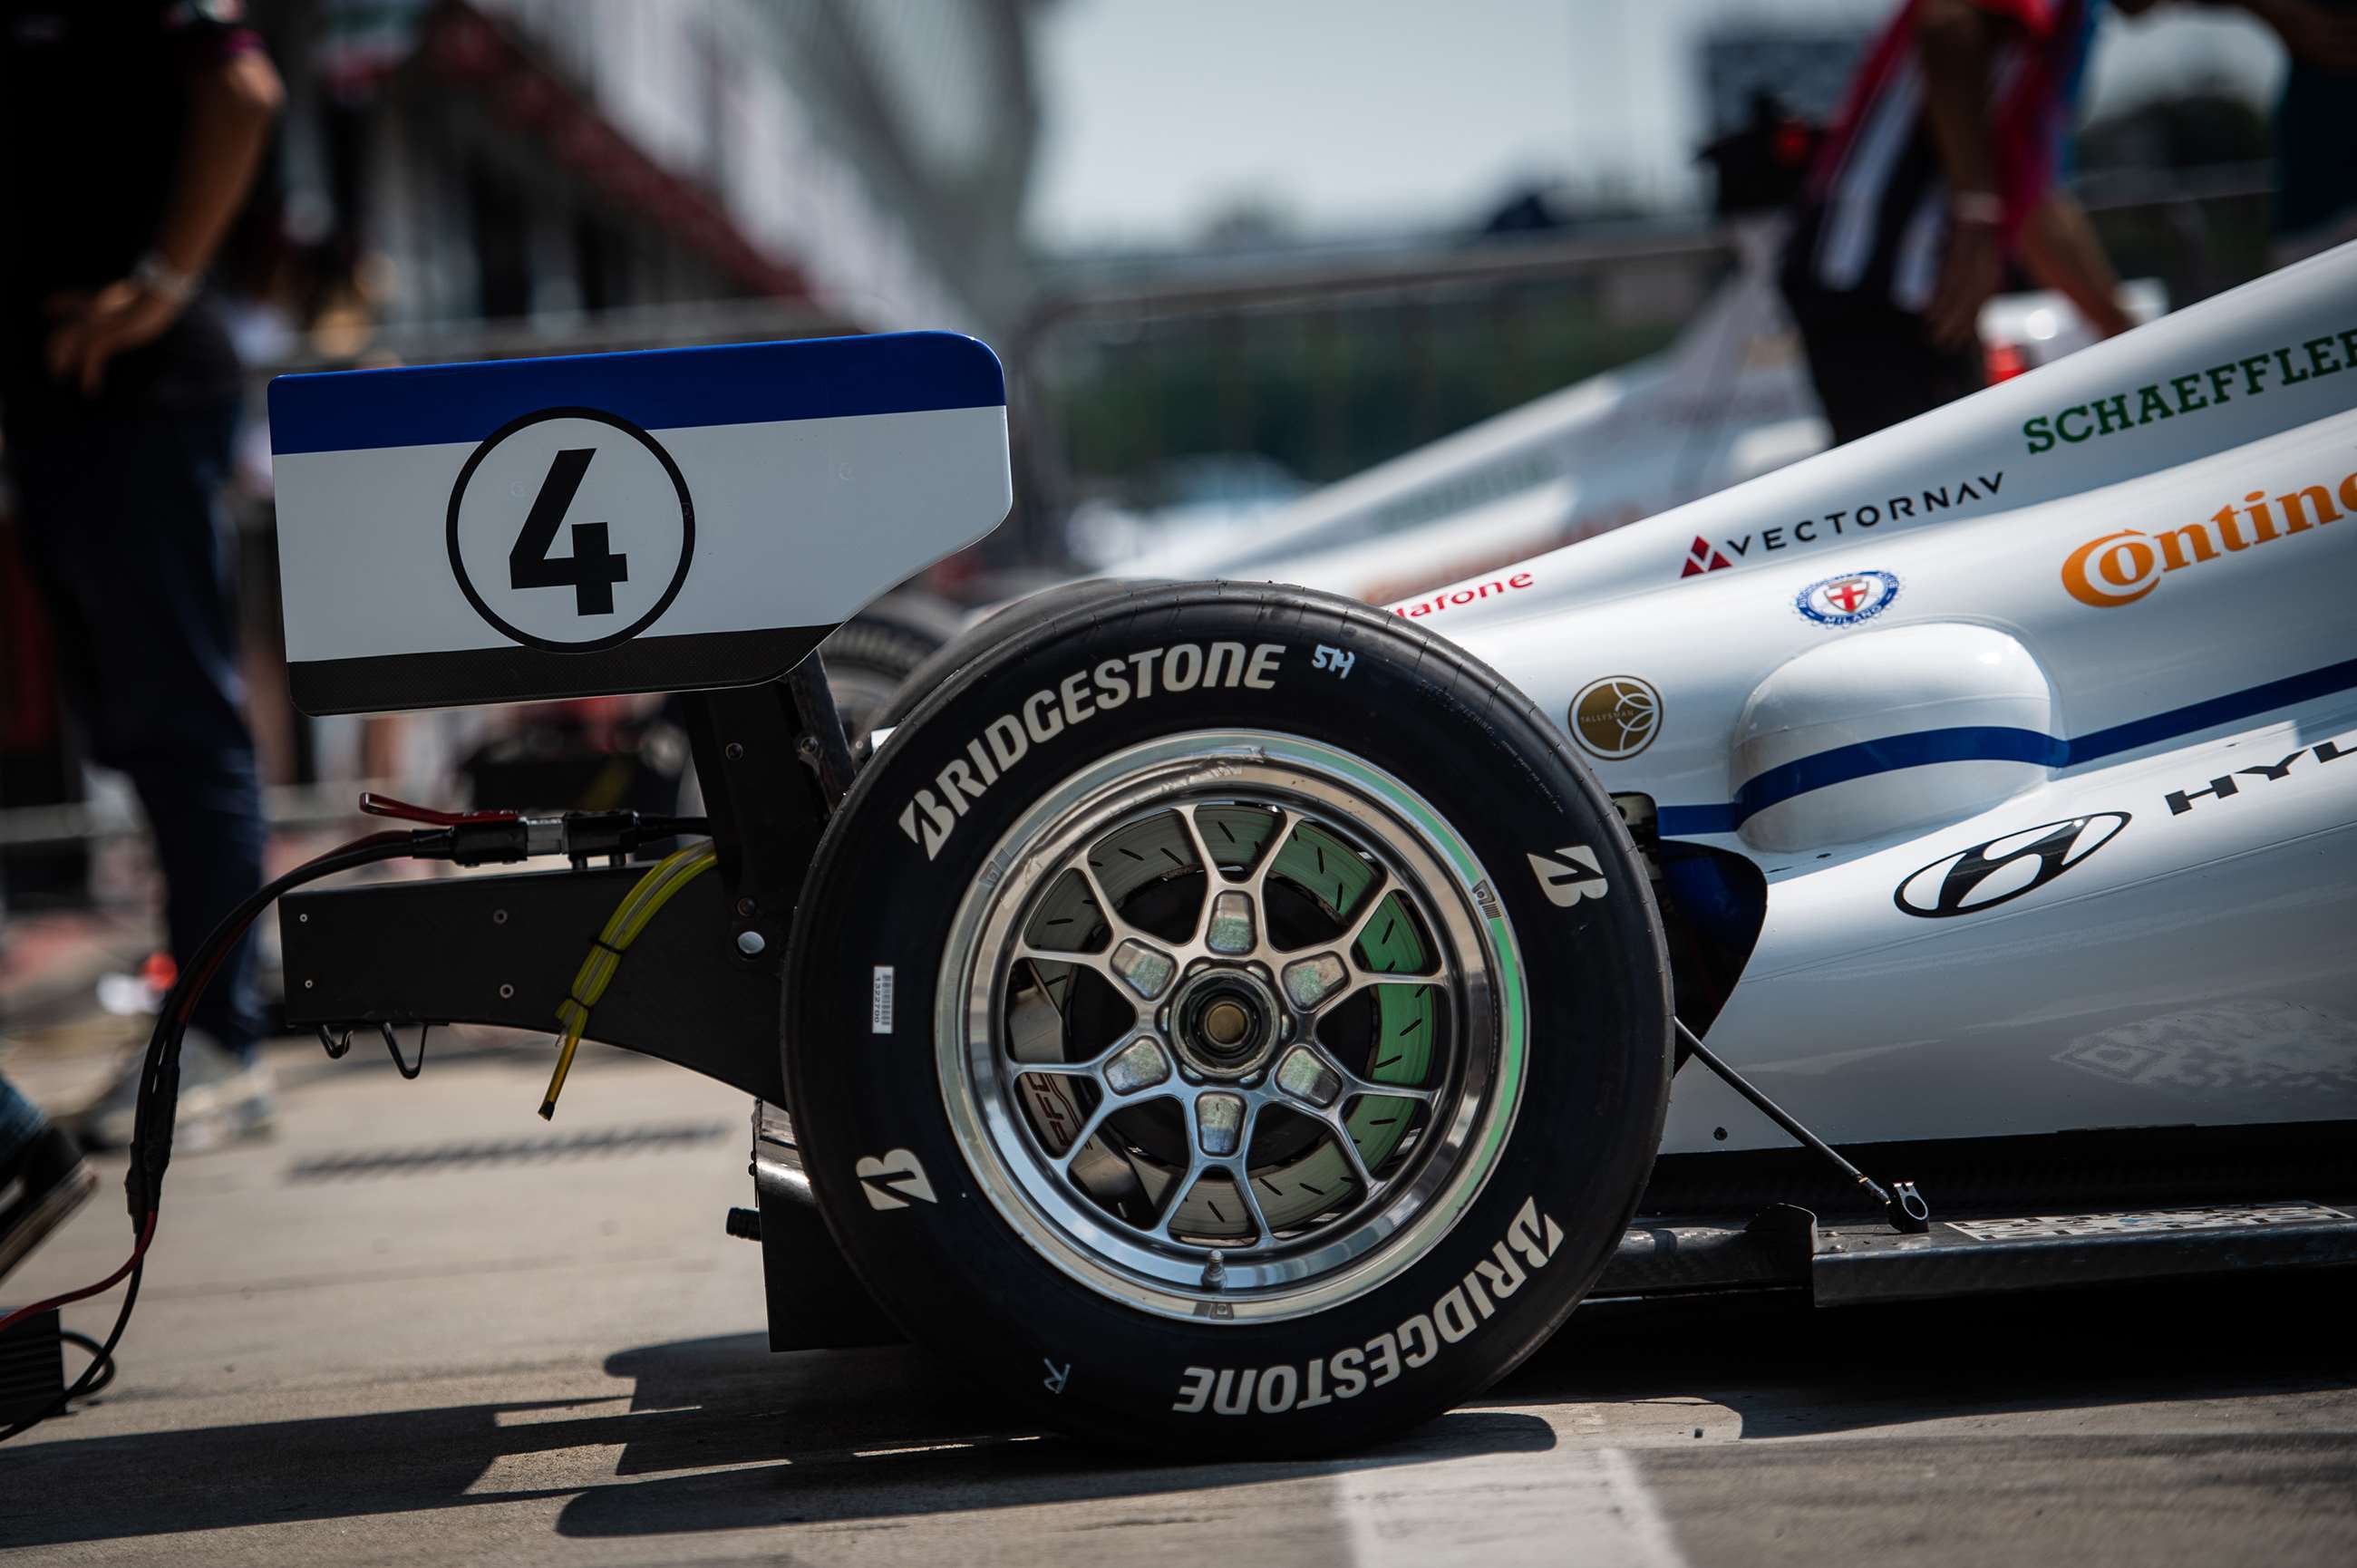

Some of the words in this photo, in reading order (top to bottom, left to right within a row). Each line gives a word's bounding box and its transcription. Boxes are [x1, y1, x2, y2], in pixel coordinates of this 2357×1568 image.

[509, 448, 628, 616] 4
[1726, 471, 2003, 557] VECTORNAV
[1824, 605, 1882, 624] MILANO
[898, 641, 1286, 861] BRIDGESTONE
[1172, 1195, 1565, 1416] BRIDGESTONE
